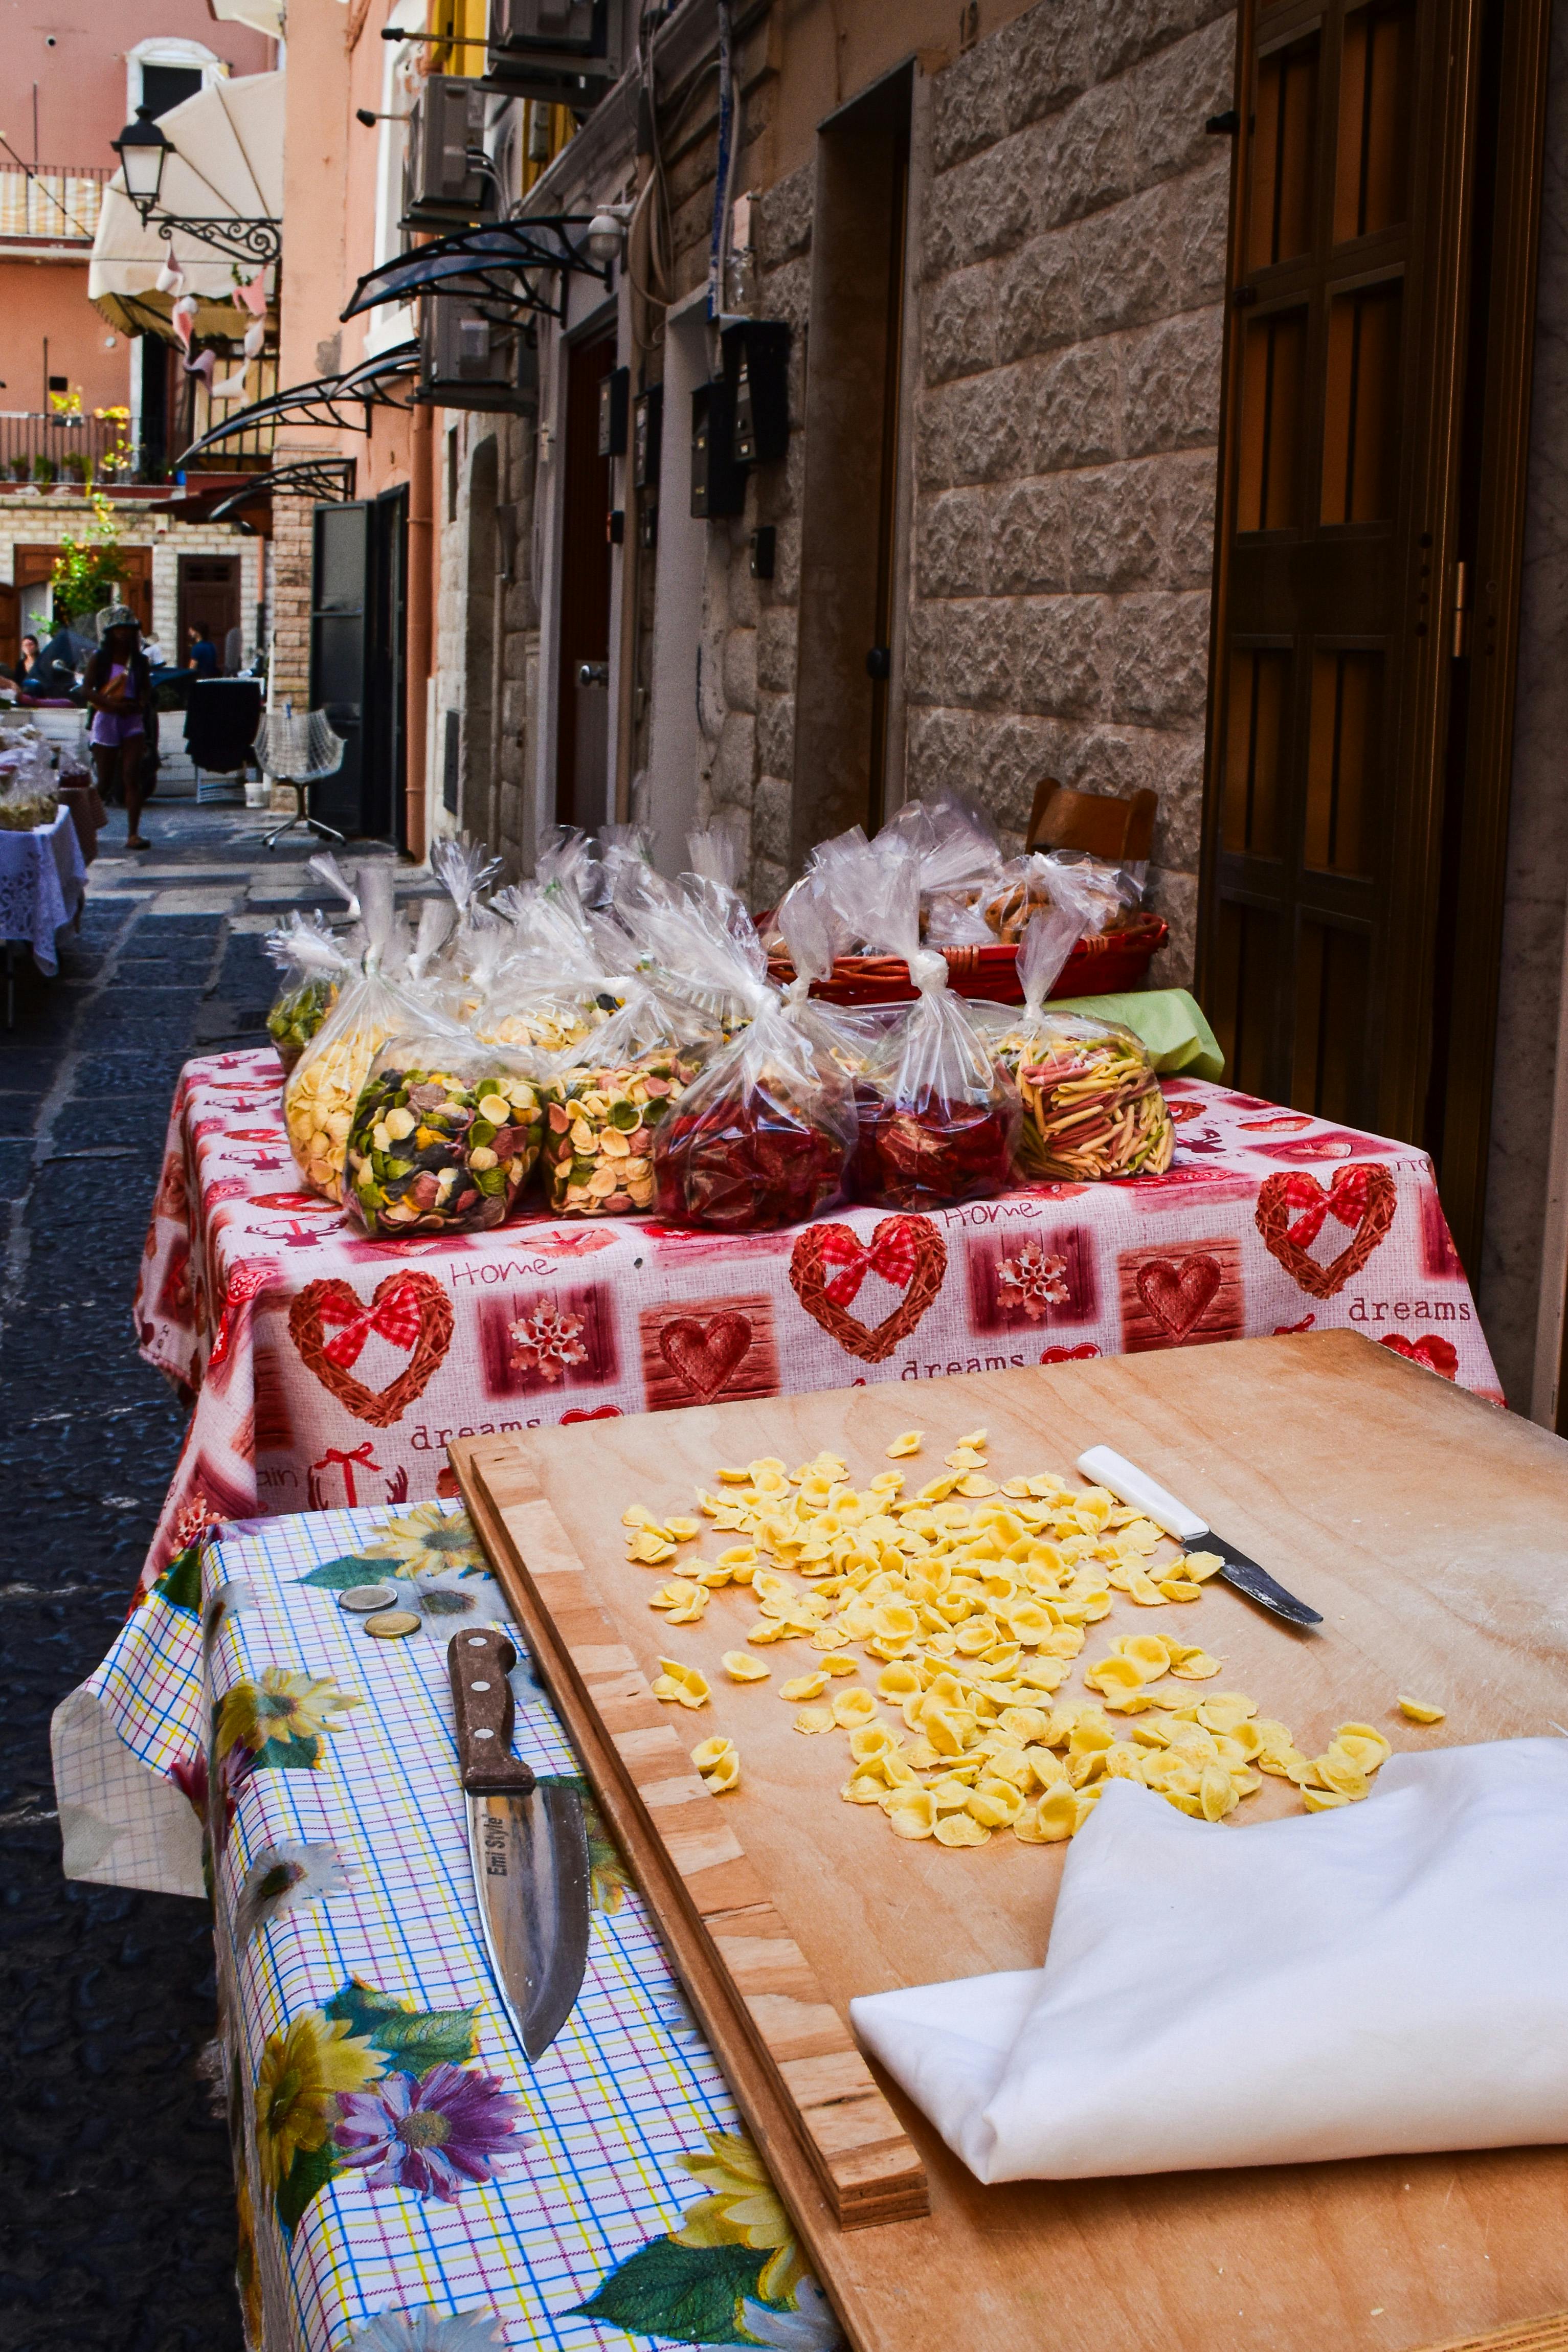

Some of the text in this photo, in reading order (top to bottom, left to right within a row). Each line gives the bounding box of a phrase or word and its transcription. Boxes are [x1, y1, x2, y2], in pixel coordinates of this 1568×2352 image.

[944, 1201, 1043, 1227] Home
[451, 1258, 558, 1287] Home
[1349, 1297, 1471, 1321] dreams
[902, 1354, 1024, 1381] dreams
[485, 1851, 508, 1876] Emi
